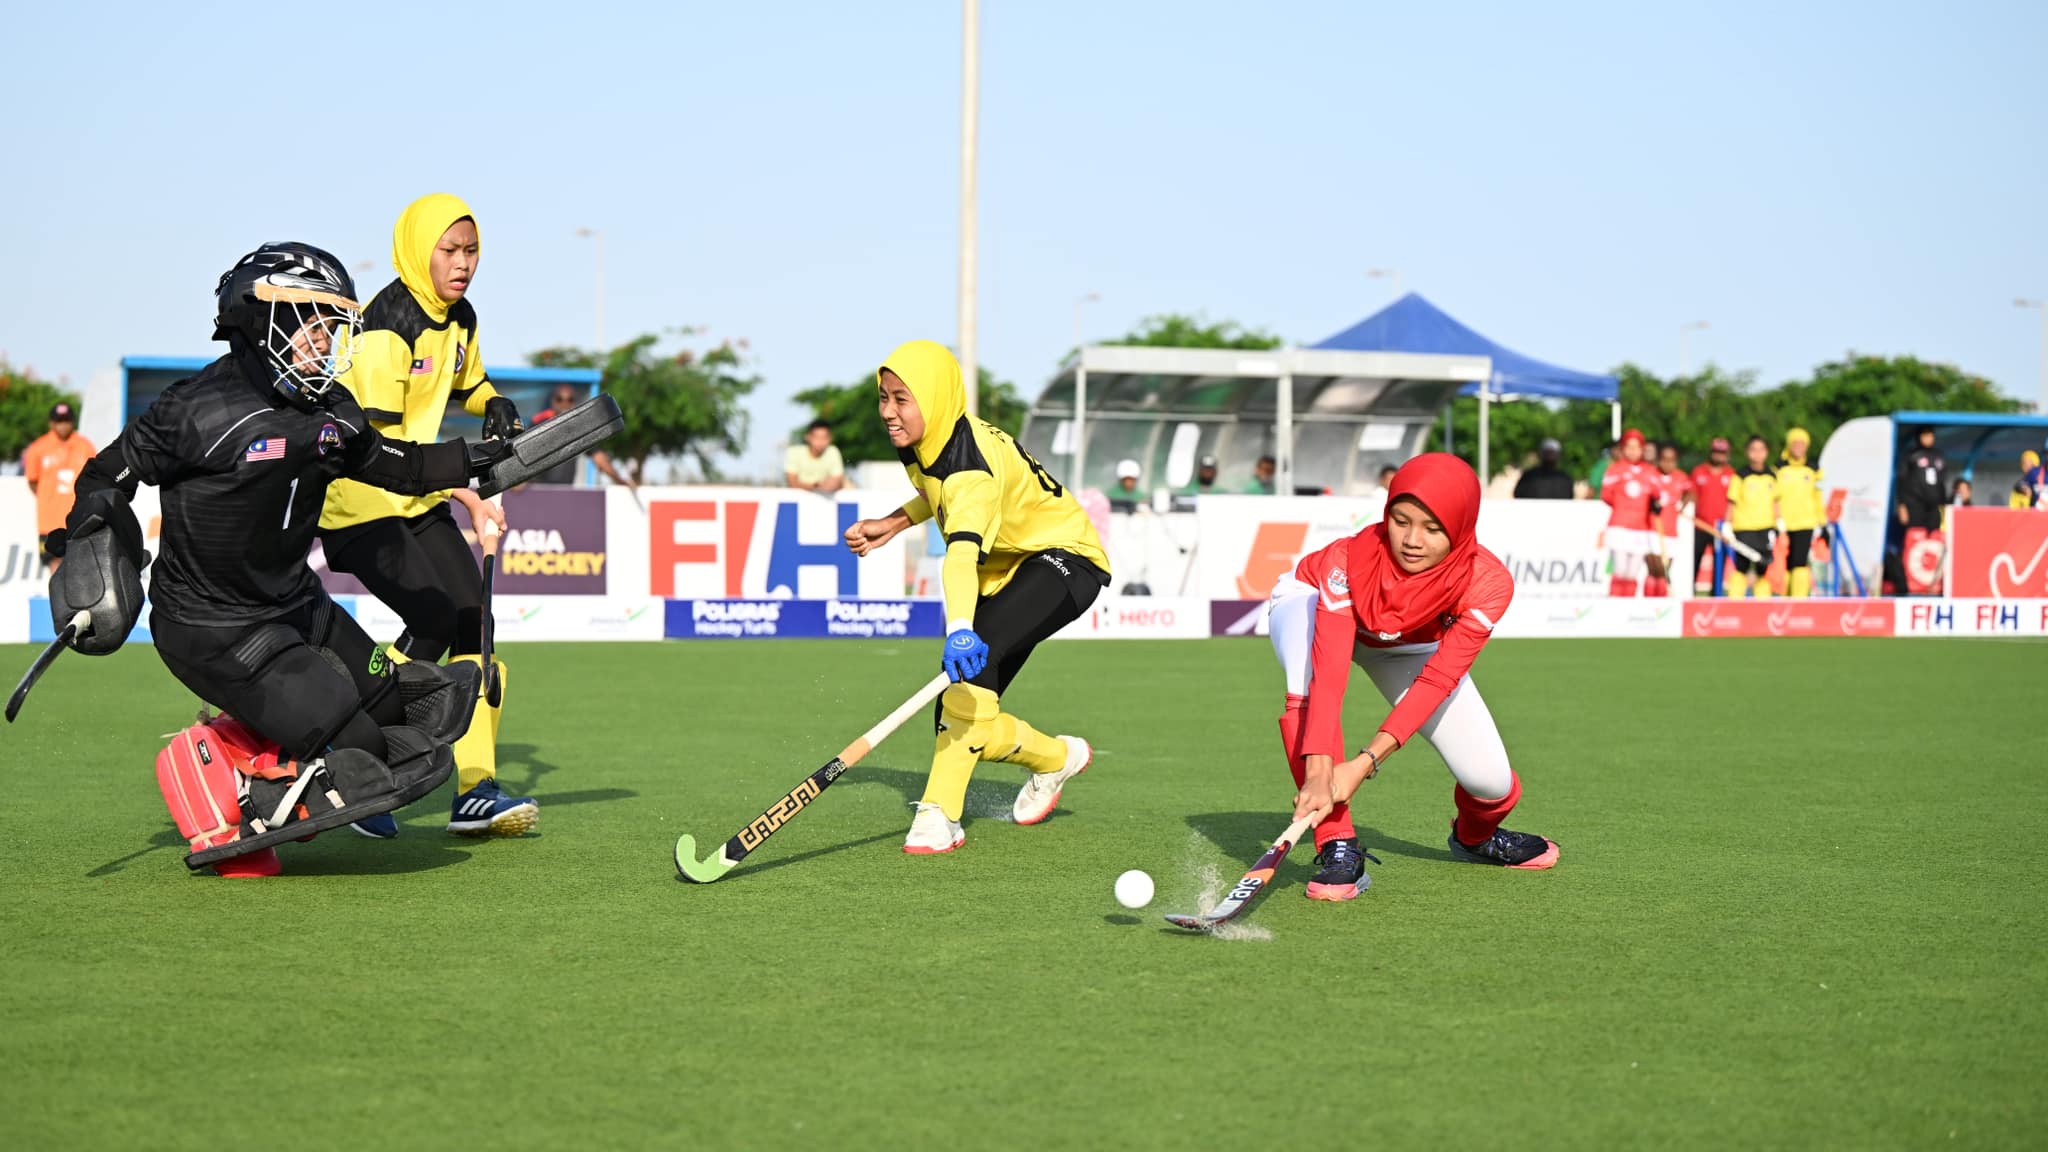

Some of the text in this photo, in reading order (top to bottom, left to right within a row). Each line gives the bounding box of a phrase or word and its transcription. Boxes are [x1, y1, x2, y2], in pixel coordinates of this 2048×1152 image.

[282, 477, 299, 530] 1
[502, 529, 566, 553] ASIA
[650, 501, 858, 600] FIH
[502, 552, 605, 576] HOCKEY
[694, 620, 777, 638] Hockey Turfs
[827, 620, 908, 638] Hockey Turfs
[1119, 609, 1175, 626] Hero
[1911, 605, 1953, 630] FIH
[1976, 605, 2018, 630] FIH
